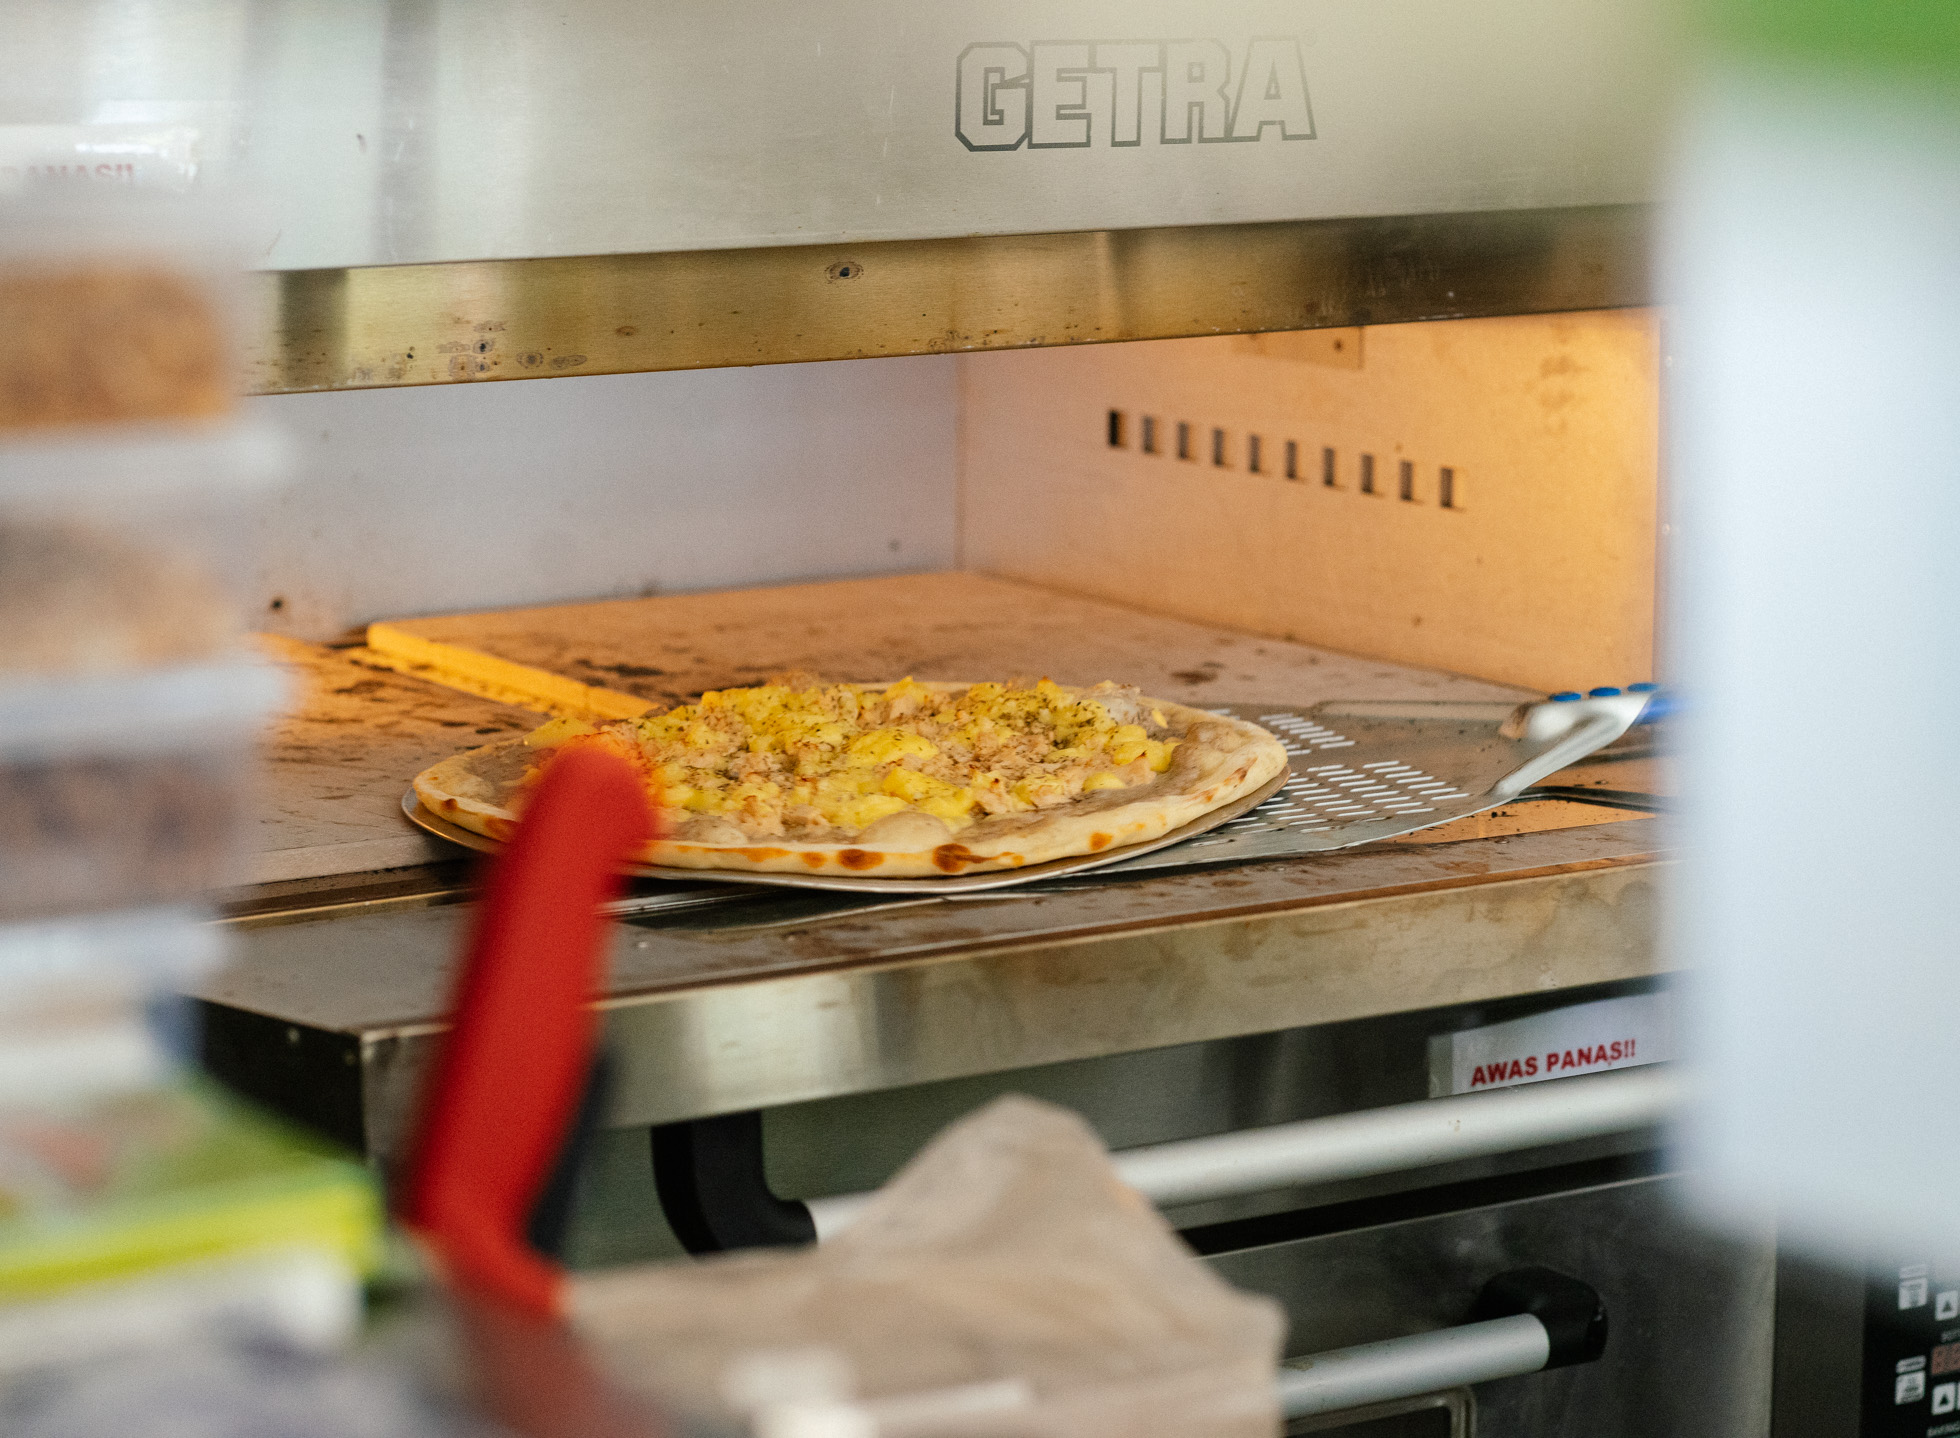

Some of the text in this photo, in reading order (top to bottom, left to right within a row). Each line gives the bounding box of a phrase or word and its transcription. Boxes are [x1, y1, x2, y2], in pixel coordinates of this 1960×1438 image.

[955, 35, 1317, 152] GETRA
[1470, 1038, 1636, 1087] AWAS PANAS!!
